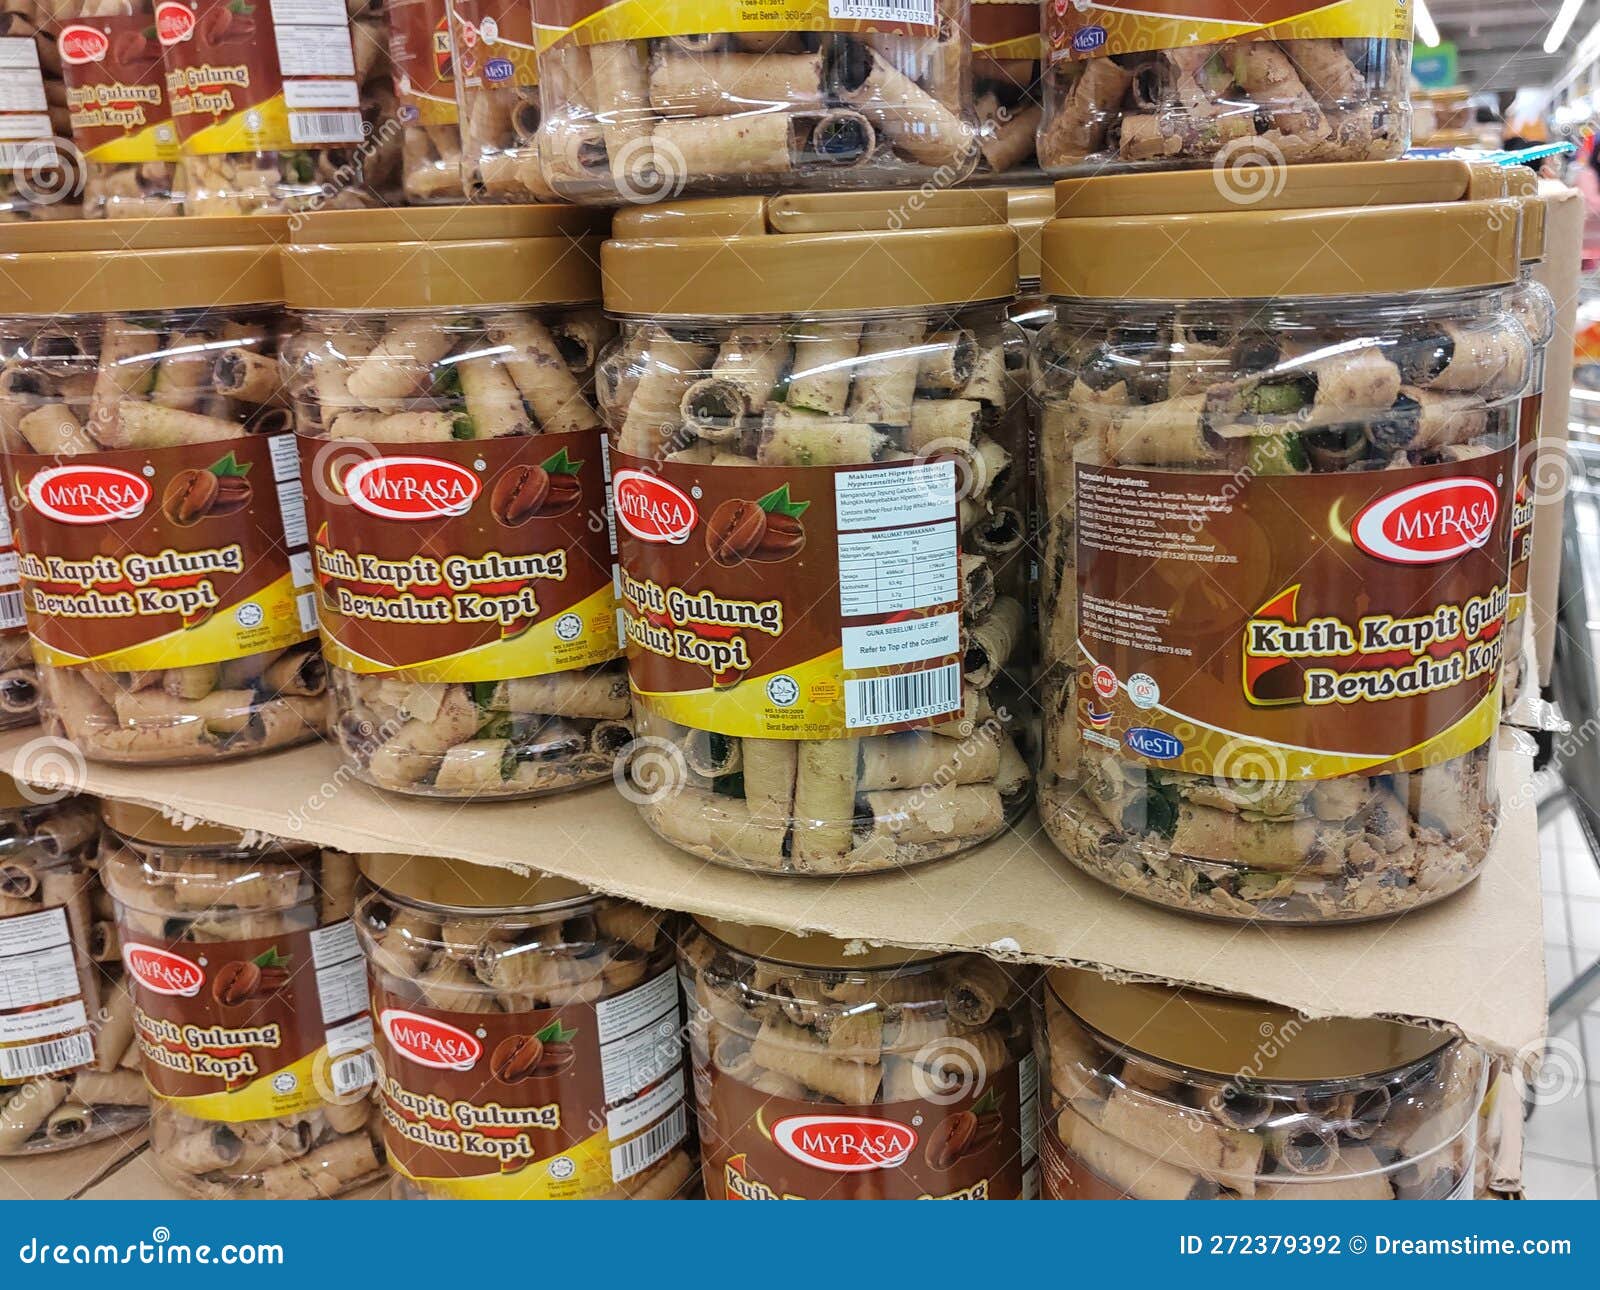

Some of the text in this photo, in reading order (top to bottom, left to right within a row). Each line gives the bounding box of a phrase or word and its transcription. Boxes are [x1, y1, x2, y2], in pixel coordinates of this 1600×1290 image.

[849, 7, 890, 18] 557526
[897, 10, 930, 22] 990380
[1075, 32, 1104, 48] MeSTI
[188, 67, 247, 86] Gulung
[97, 84, 160, 103] Gulung
[194, 93, 233, 112] Kopi
[105, 110, 144, 127] Kopi
[49, 483, 141, 507] MYRASA
[368, 477, 468, 502] MYRASA
[621, 488, 687, 527] MYRASA
[1395, 501, 1491, 541] MYRASA
[51, 559, 117, 584] Kapit
[126, 547, 239, 581] Gulung
[318, 549, 564, 587] Kuih Kapit Gulung
[36, 584, 216, 616] Bersalut Kopi
[342, 591, 535, 622] Bersalut Kopi
[669, 591, 778, 631] Gulung
[866, 629, 884, 637] GUNA
[885, 626, 914, 635] SEBELUM
[918, 622, 928, 630] USE
[1252, 590, 1508, 652] Kuih Kapit Gulu
[676, 634, 748, 670] Kopi
[860, 635, 949, 654] Refer to Top of the Container
[1130, 674, 1156, 688] HACCP
[1309, 657, 1461, 699] Bersalut
[850, 700, 956, 726] 9 557526 990380
[1129, 734, 1178, 756] MeSTI
[133, 956, 195, 985] MYRASA
[185, 1026, 277, 1048] Gulung
[393, 1026, 472, 1059] MYRASA
[195, 1055, 254, 1078] Kopi
[391, 1083, 557, 1127] Kapit Gulung
[384, 1108, 531, 1159] ersalut Kopi
[802, 1131, 905, 1154] MYRASA
